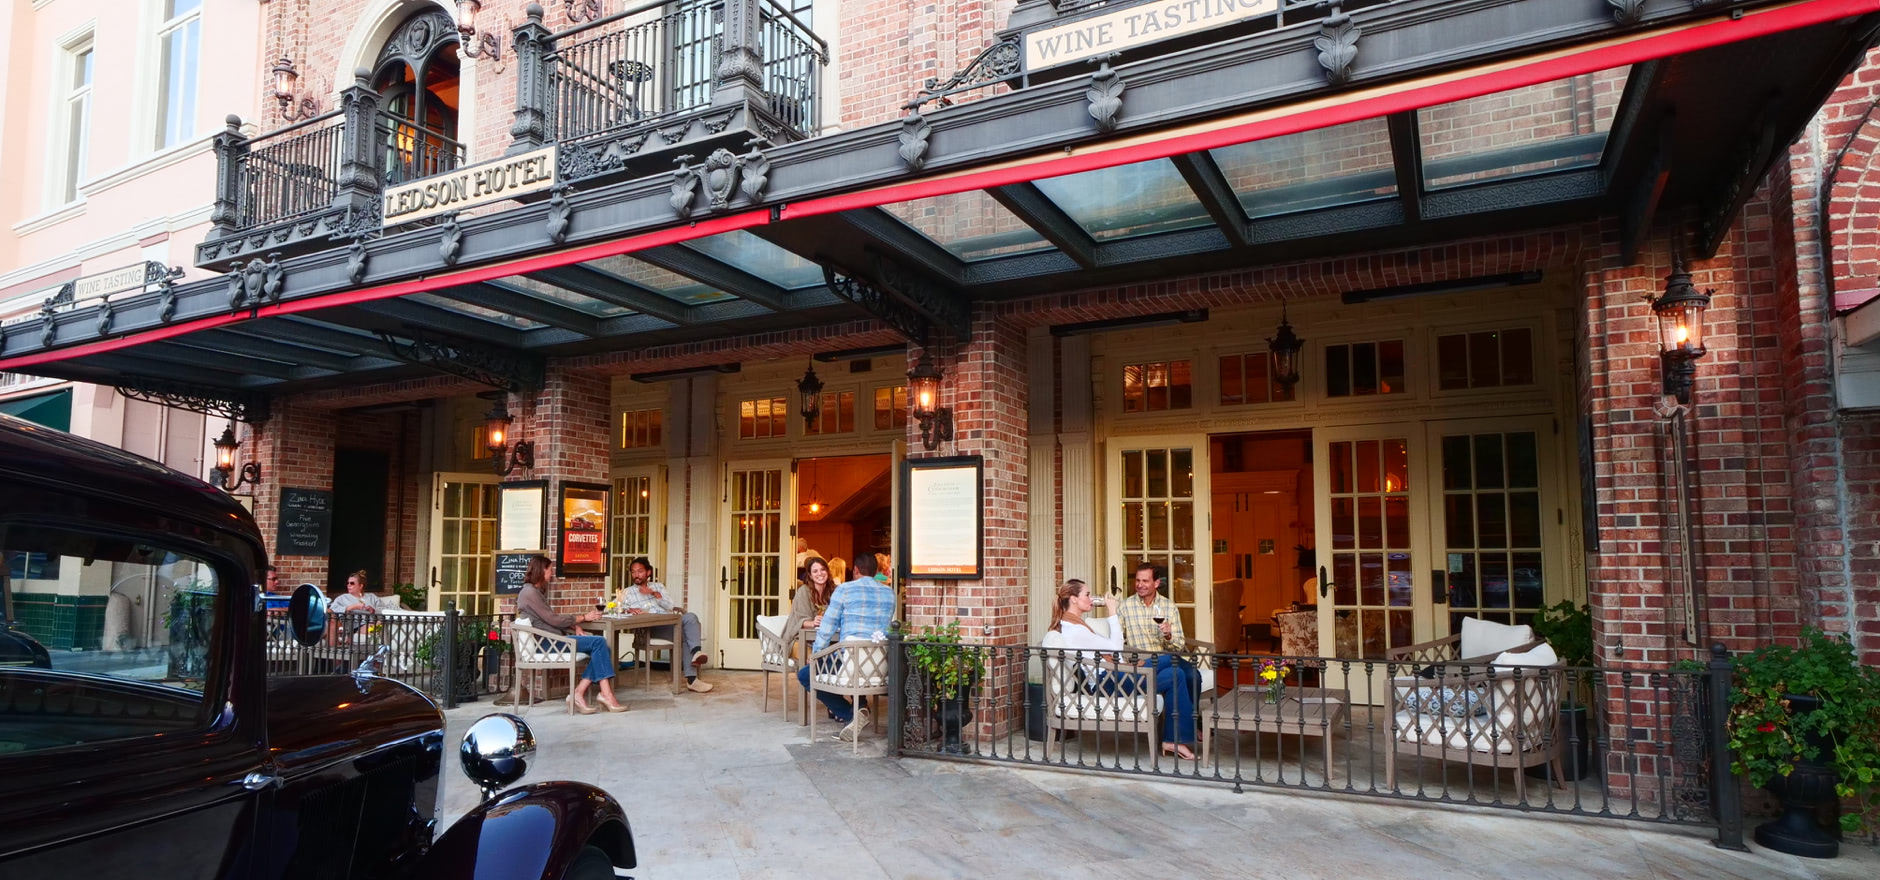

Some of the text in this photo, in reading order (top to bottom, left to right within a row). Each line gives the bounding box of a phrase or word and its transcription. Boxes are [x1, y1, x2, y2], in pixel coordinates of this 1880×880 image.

[1035, 21, 1113, 60] WINE
[384, 155, 552, 218] LEDSON HOTEL
[78, 269, 142, 296] WINE TASTING
[569, 533, 598, 543] CORVETTES
[519, 554, 531, 565] HY
